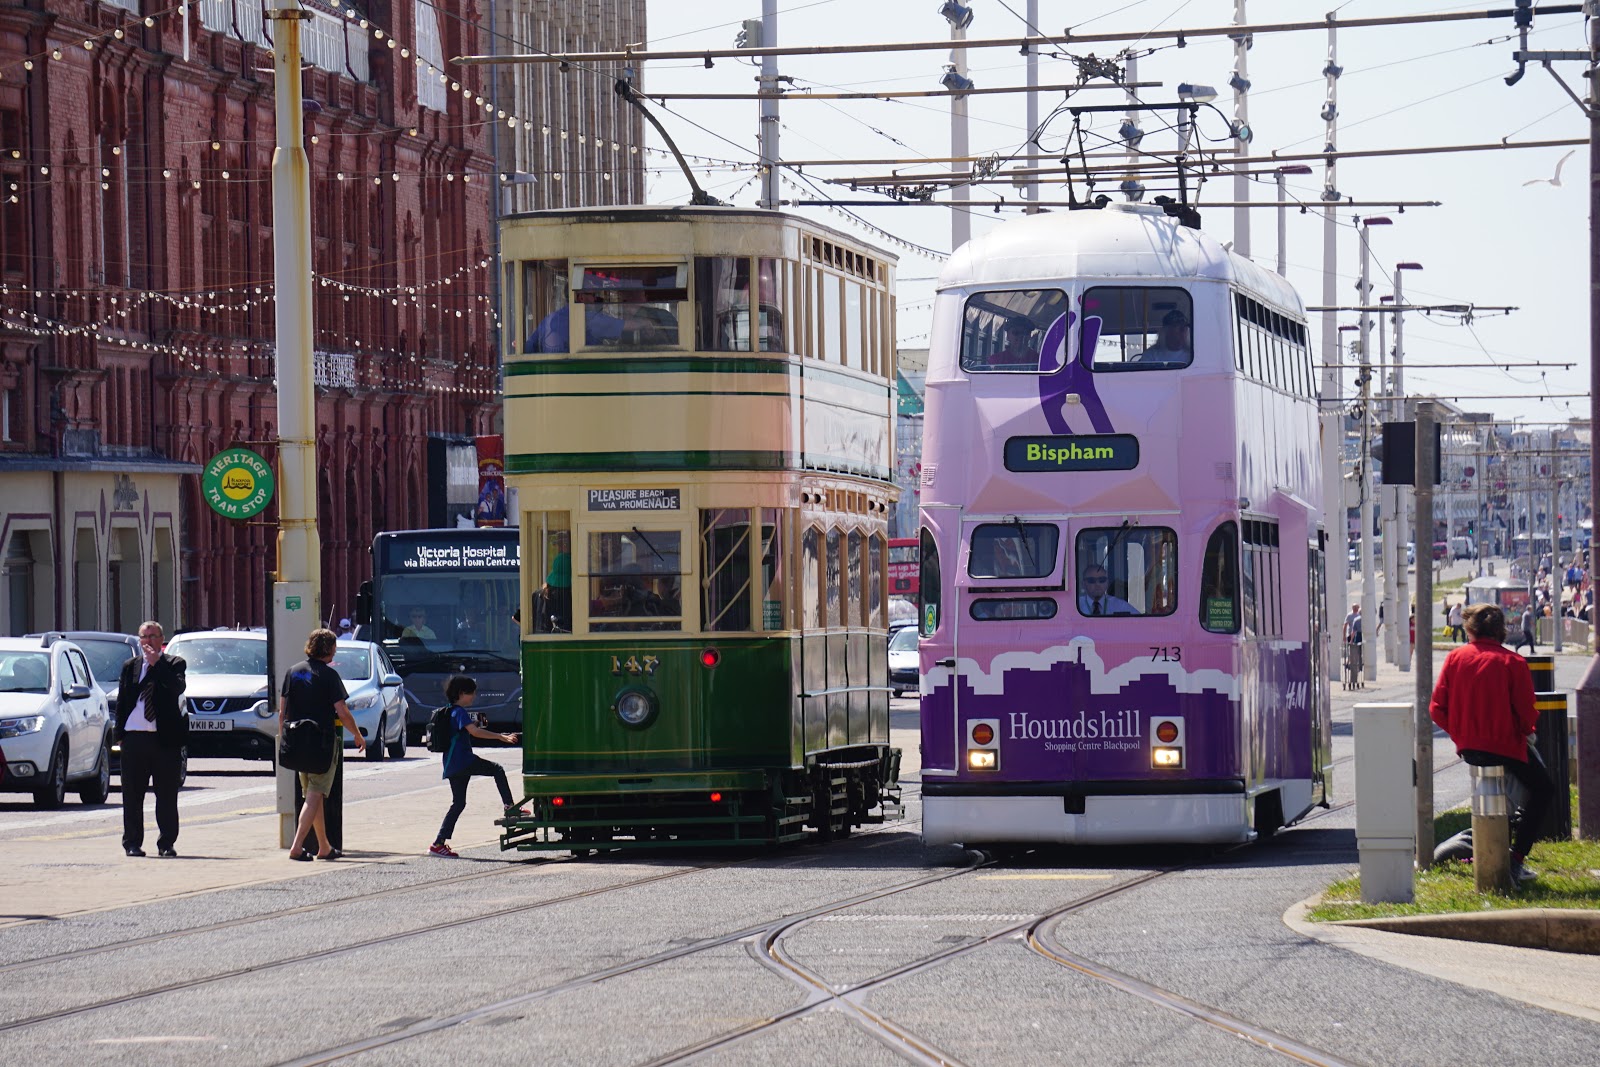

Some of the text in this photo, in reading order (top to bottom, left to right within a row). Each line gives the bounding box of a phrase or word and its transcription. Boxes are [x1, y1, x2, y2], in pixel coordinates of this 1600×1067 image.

[1027, 442, 1114, 465] Bispham
[210, 453, 268, 479] HERITAGE
[208, 486, 267, 514] TRAM STOP
[590, 489, 665, 503] PLEASURE BEACH
[602, 495, 678, 509] VIA PROMENADE
[416, 545, 460, 559] Victoria
[462, 545, 507, 558] Hospital
[403, 556, 517, 568] via Blackpool Town Centre
[1149, 646, 1182, 662] 713
[611, 654, 660, 674] 147
[208, 721, 226, 730] RJO
[1008, 709, 1142, 740] Houndshill
[1044, 740, 1141, 752] Shopping Centre Blackpool
